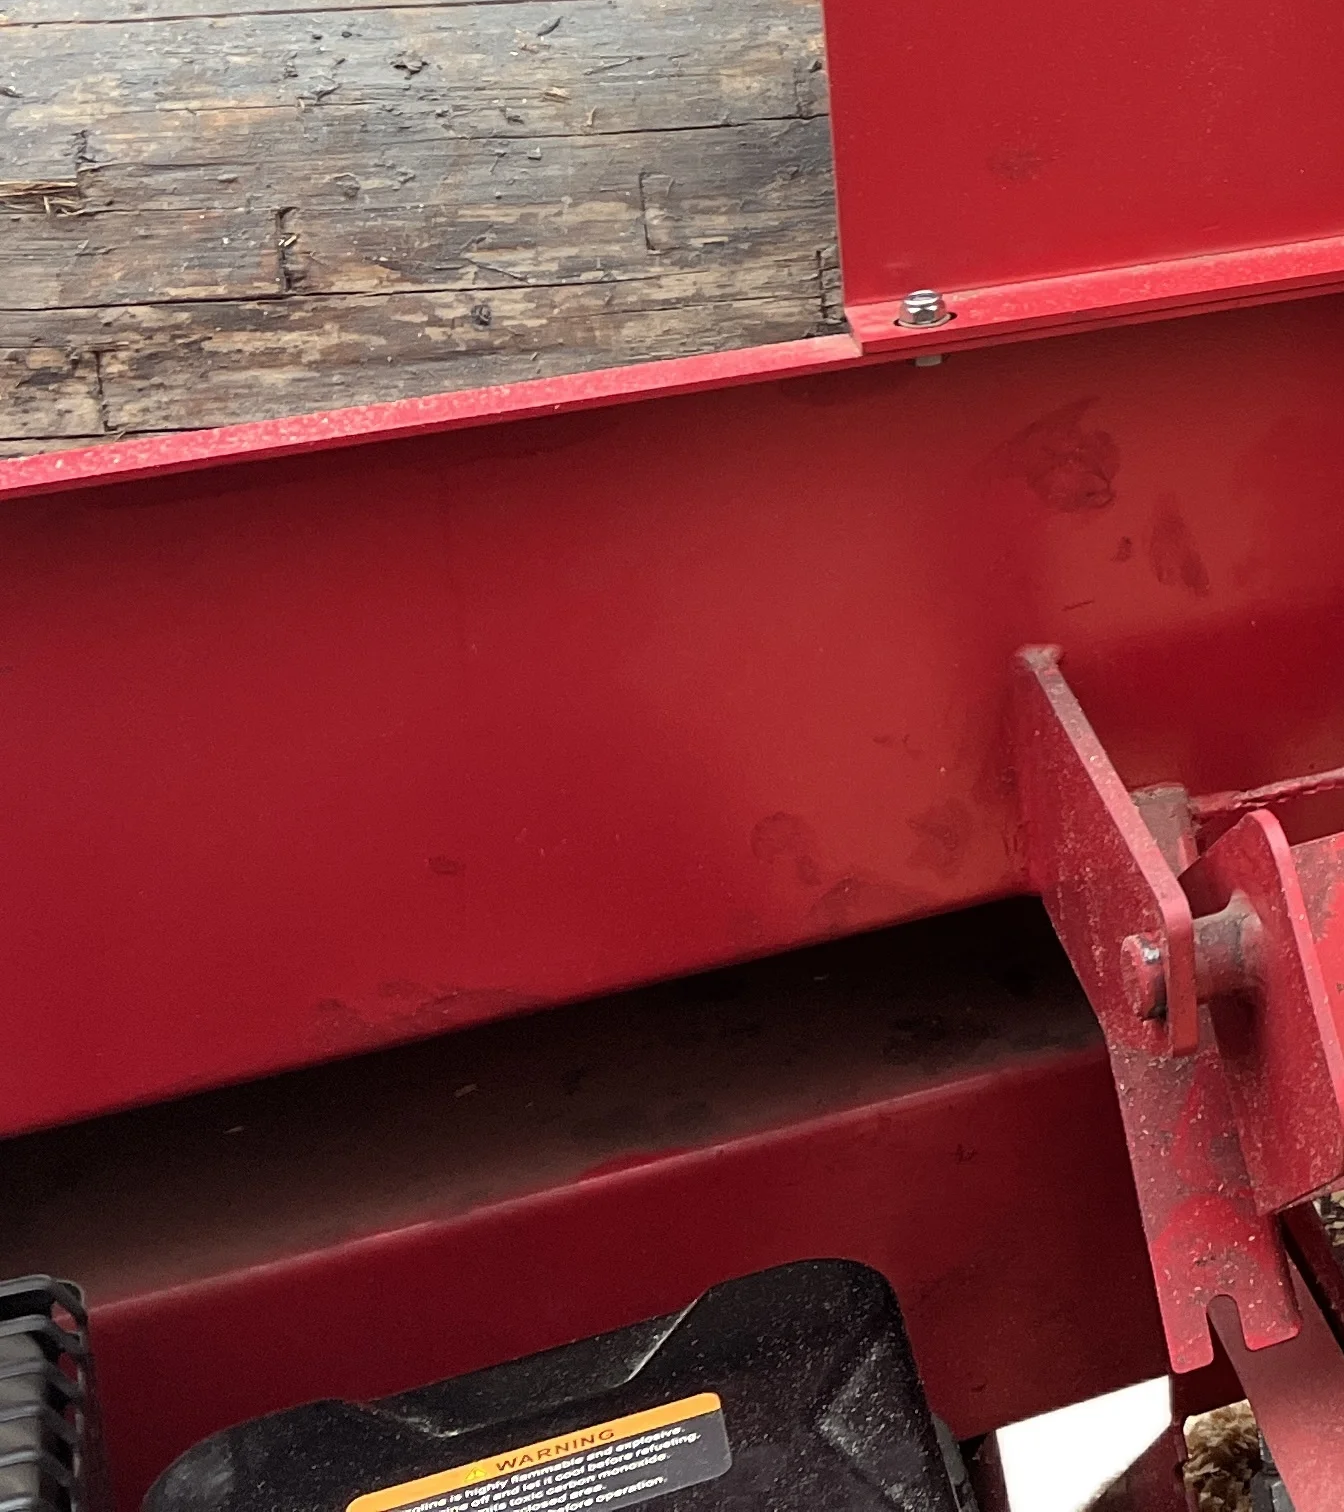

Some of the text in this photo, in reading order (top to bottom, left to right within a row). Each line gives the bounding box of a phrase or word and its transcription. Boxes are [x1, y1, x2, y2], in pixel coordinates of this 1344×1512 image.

[496, 1429, 615, 1471] WARNING
[586, 1445, 614, 1462] and
[470, 1494, 491, 1508] off
[492, 1485, 521, 1501] and
[522, 1479, 542, 1492] let
[554, 1465, 585, 1482] cool
[587, 1451, 634, 1472] before
[508, 1490, 545, 1507] toxic
[545, 1474, 597, 1496] carbon
